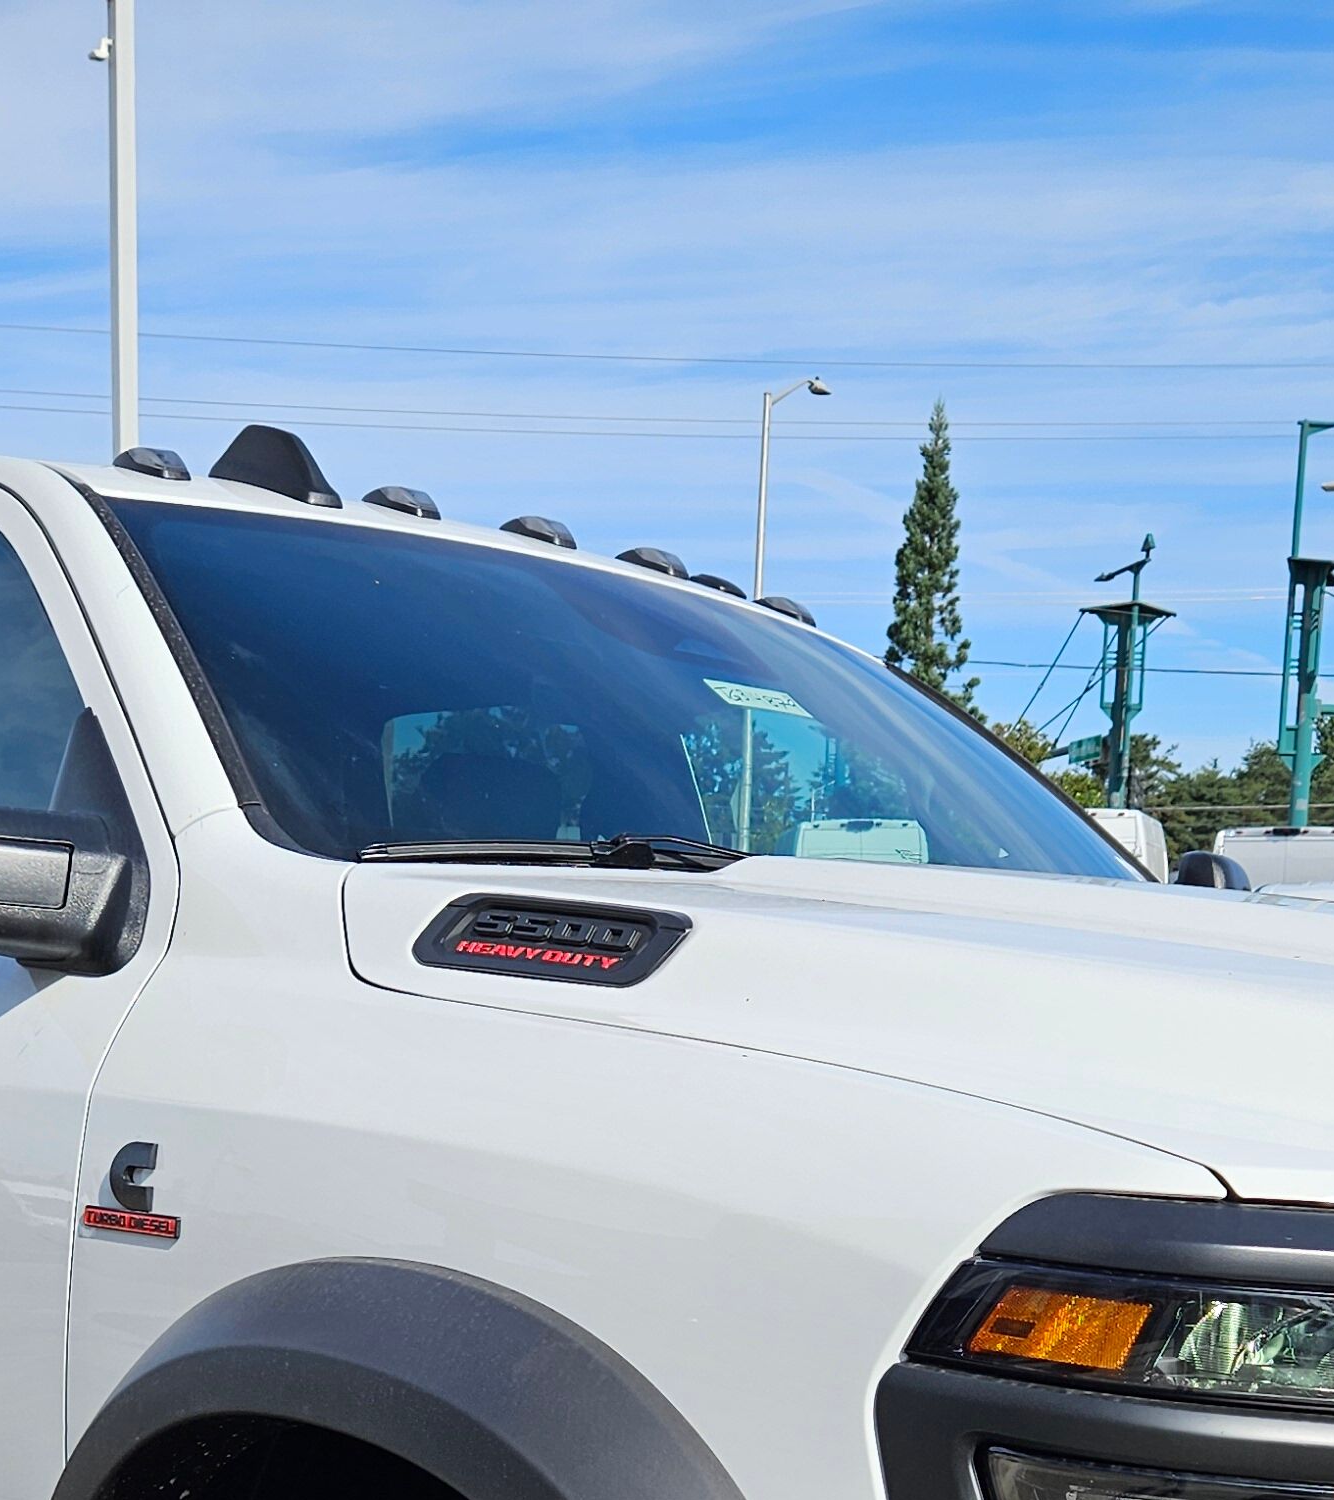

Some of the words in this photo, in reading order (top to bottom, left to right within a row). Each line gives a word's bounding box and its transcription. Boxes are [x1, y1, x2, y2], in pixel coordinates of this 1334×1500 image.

[472, 909, 643, 952] 5500
[455, 940, 542, 961] HEAVY
[542, 950, 621, 970] DUTY
